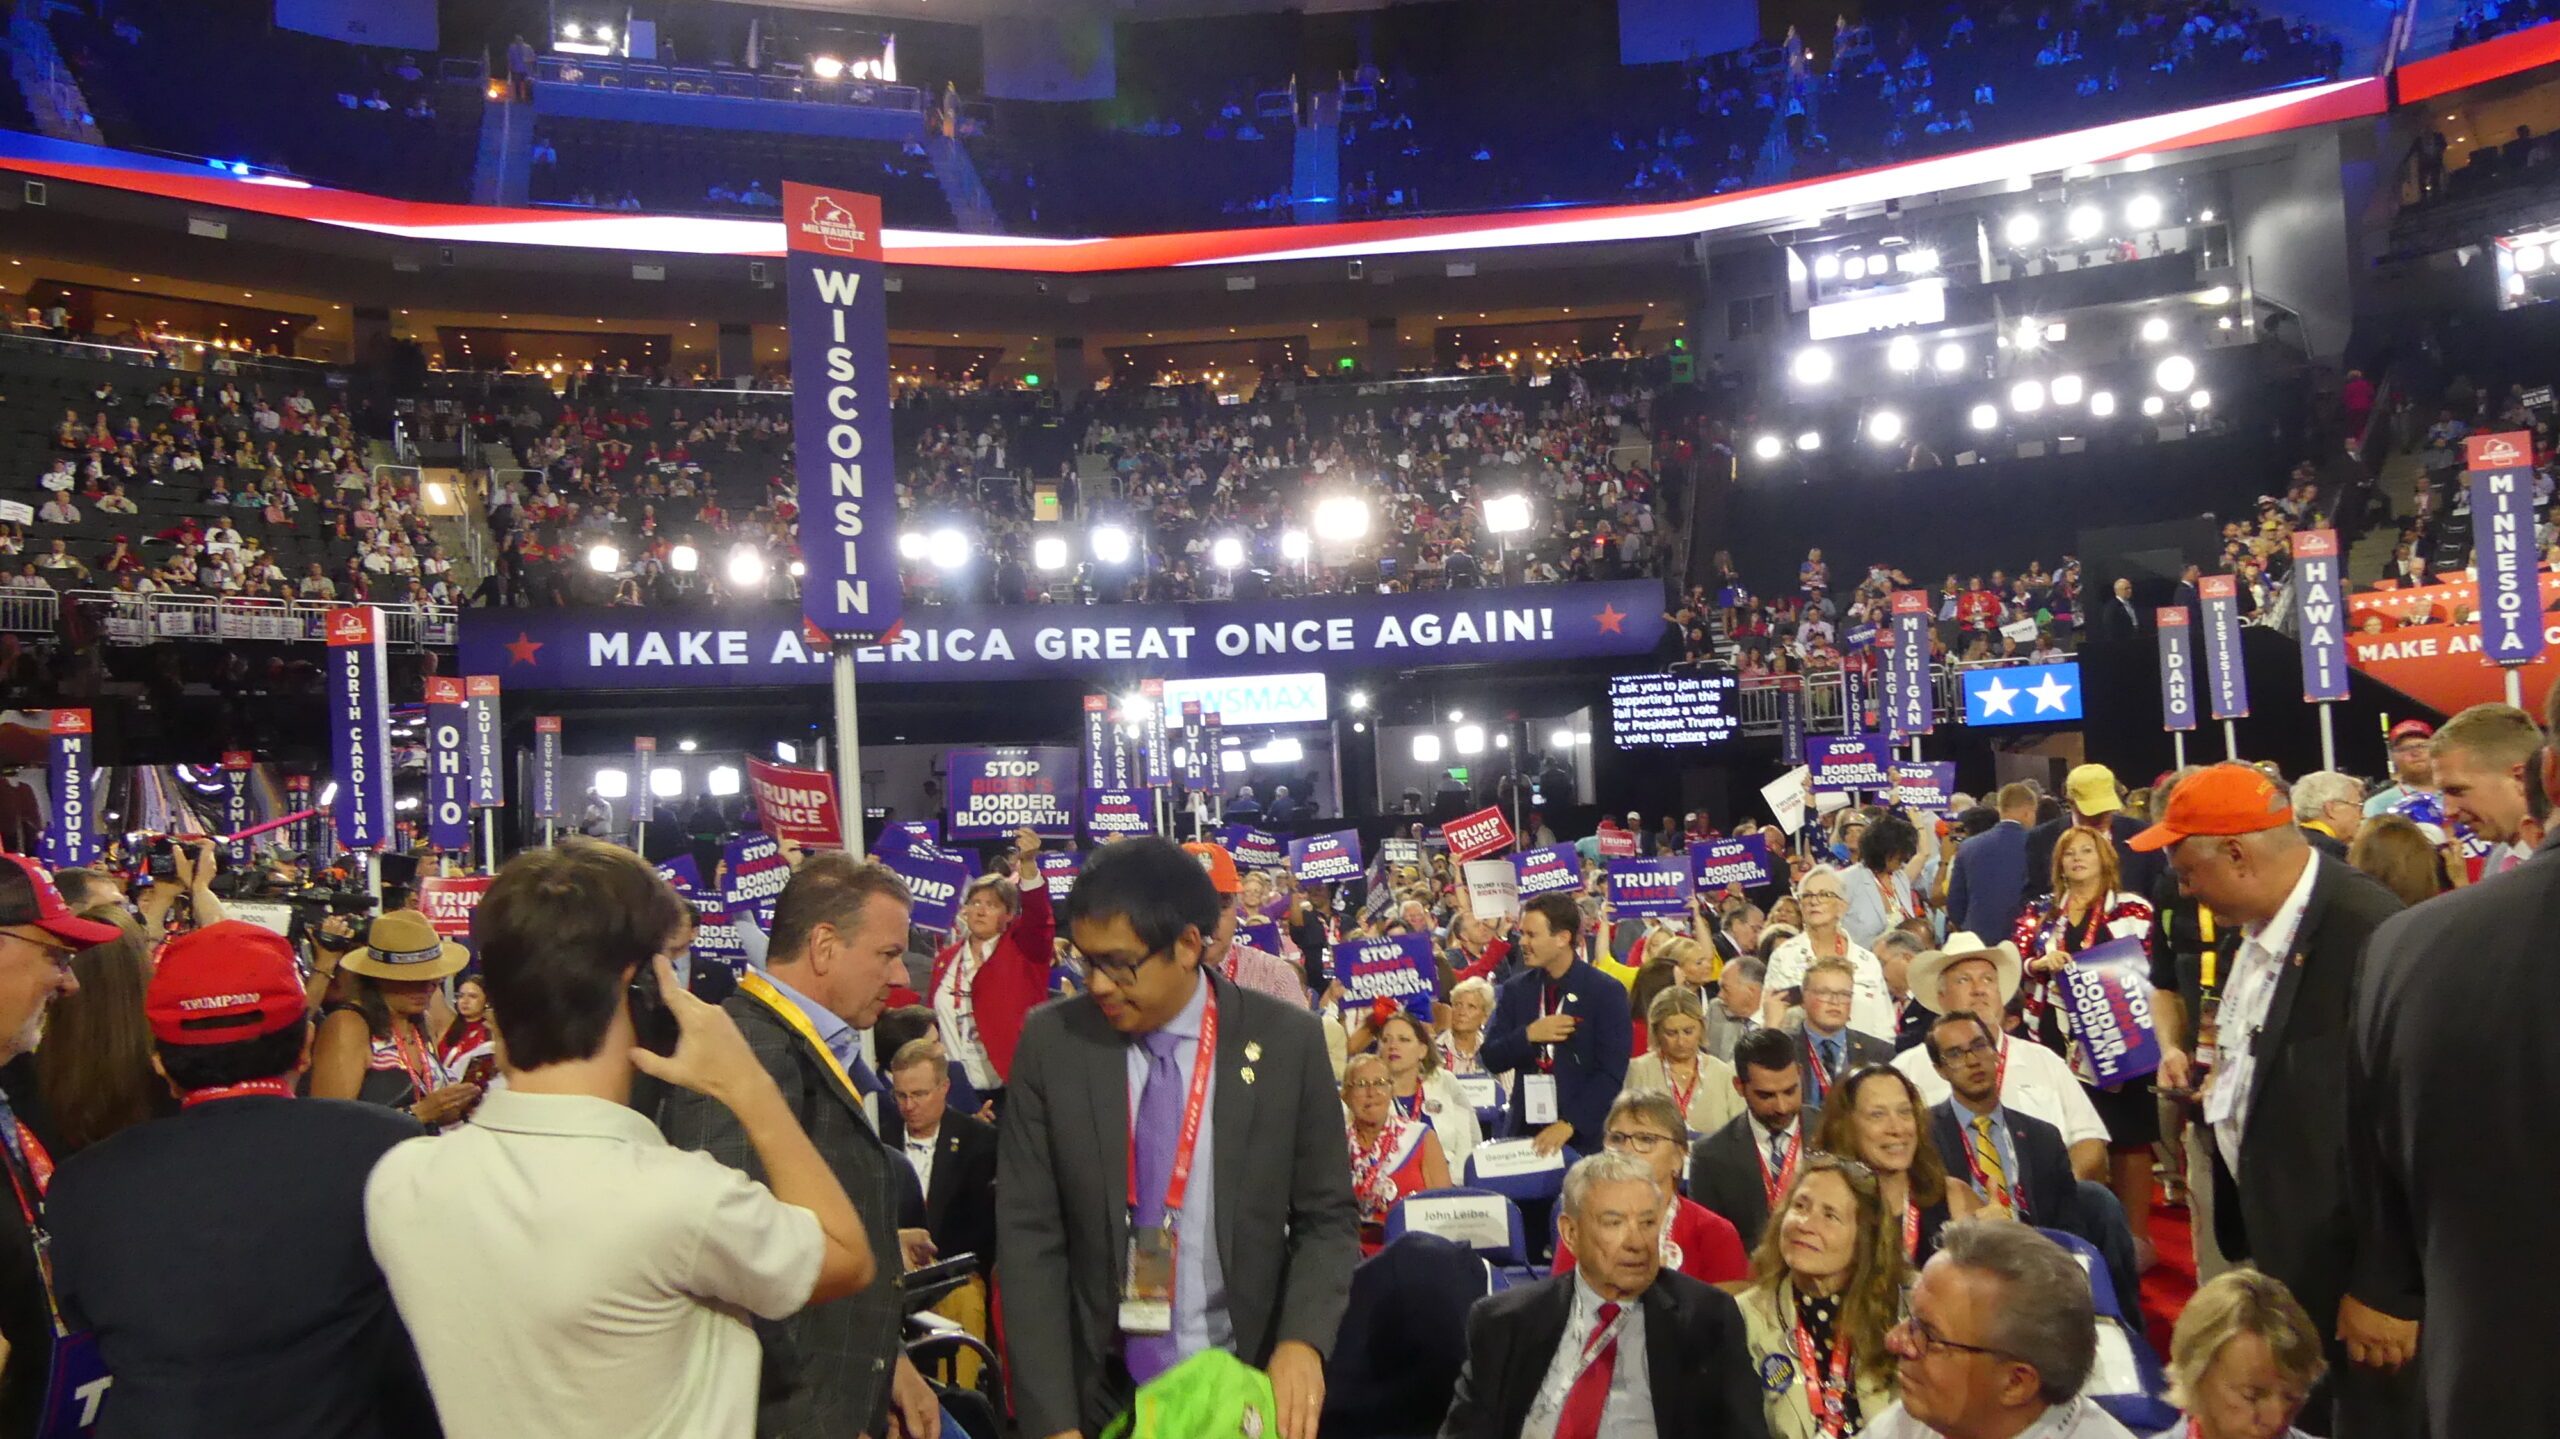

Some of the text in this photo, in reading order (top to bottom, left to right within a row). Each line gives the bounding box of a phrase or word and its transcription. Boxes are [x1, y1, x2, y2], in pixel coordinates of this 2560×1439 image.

[802, 223, 865, 240] MILWAUKEE
[812, 268, 869, 614] WISCONSIN
[2488, 474, 2524, 651] MINNESOTA
[2303, 562, 2334, 689] HAWAII
[588, 607, 1555, 667] MAKE AERICA GREAT ONCE AGAIN!
[2212, 601, 2234, 710] MISSISSIPPI
[2357, 638, 2438, 663] MAKE
[1902, 617, 1922, 725] MICHIGAN
[2167, 638, 2187, 715] IDAHO
[345, 651, 362, 720] NORTH
[1618, 682, 1639, 693] ask
[1640, 682, 1662, 694] you
[1664, 681, 1677, 691] to
[1678, 679, 1699, 692] join
[1701, 680, 1720, 689] me
[1722, 677, 1735, 688] in
[1612, 690, 1721, 707] supporting him this
[1884, 649, 1901, 740] VIRGINIA
[1613, 704, 1718, 719] fall because a vote
[1850, 674, 1862, 735] COLORA
[1614, 714, 1737, 732] for President Trump is
[1614, 730, 1730, 744] a vote to restore our
[478, 700, 493, 800] LOUISIANA
[1091, 712, 1104, 789] MARYLAND
[1113, 723, 1127, 789] ALASKA
[1186, 725, 1200, 778] UTAH
[1829, 743, 1865, 754] STOP
[438, 725, 461, 825] OHIO
[985, 761, 1040, 778] STOP
[1822, 763, 1877, 775] BORDER
[1899, 768, 1933, 779] STOP
[350, 728, 368, 839] CAROLINA
[971, 778, 1055, 793] BIDEN'S
[1813, 773, 1887, 785] BLOODBATH
[753, 778, 828, 808] TRUMP
[1898, 785, 1940, 797] ORDER
[62, 738, 82, 862] MISSOURI
[970, 794, 1056, 811] BORDER
[1101, 795, 1131, 805] STOP
[229, 772, 245, 859] WYOMING
[956, 810, 1069, 826] BLOODBATH
[1095, 813, 1140, 823] BORDER
[1089, 822, 1148, 831] BLOODBATH
[1449, 817, 1500, 843] TRUMP
[1247, 833, 1276, 845] STOP
[1308, 840, 1338, 853] STOP
[1457, 828, 1500, 850] VANCE
[1602, 837, 1632, 846] TRUMP
[742, 842, 777, 862] STOP
[1236, 846, 1280, 859] BORDER
[1384, 849, 1418, 861] BLUE
[1711, 844, 1745, 857] STOP
[1044, 858, 1072, 869] STOP
[1301, 856, 1350, 871] BORDER
[1526, 853, 1556, 867] STOP
[735, 866, 791, 889] BORDER
[1294, 864, 1359, 880] BLOODBATH
[1521, 869, 1569, 886] BORDER
[1698, 869, 1766, 886] BLOODBATH
[1705, 861, 1756, 877] BORDER
[897, 873, 955, 900] UMP
[1613, 872, 1685, 888] TRUMP
[428, 891, 485, 906] TRUM
[727, 880, 786, 903] BLOODBA
[1621, 886, 1678, 899] VANCE
[435, 907, 469, 918] VAN
[1360, 944, 1403, 963] STOP
[1351, 968, 1419, 990] BORDER
[2120, 974, 2153, 1030] STOP
[2063, 960, 2119, 1077] BLOODBATH
[2081, 969, 2127, 1056] BORDER
